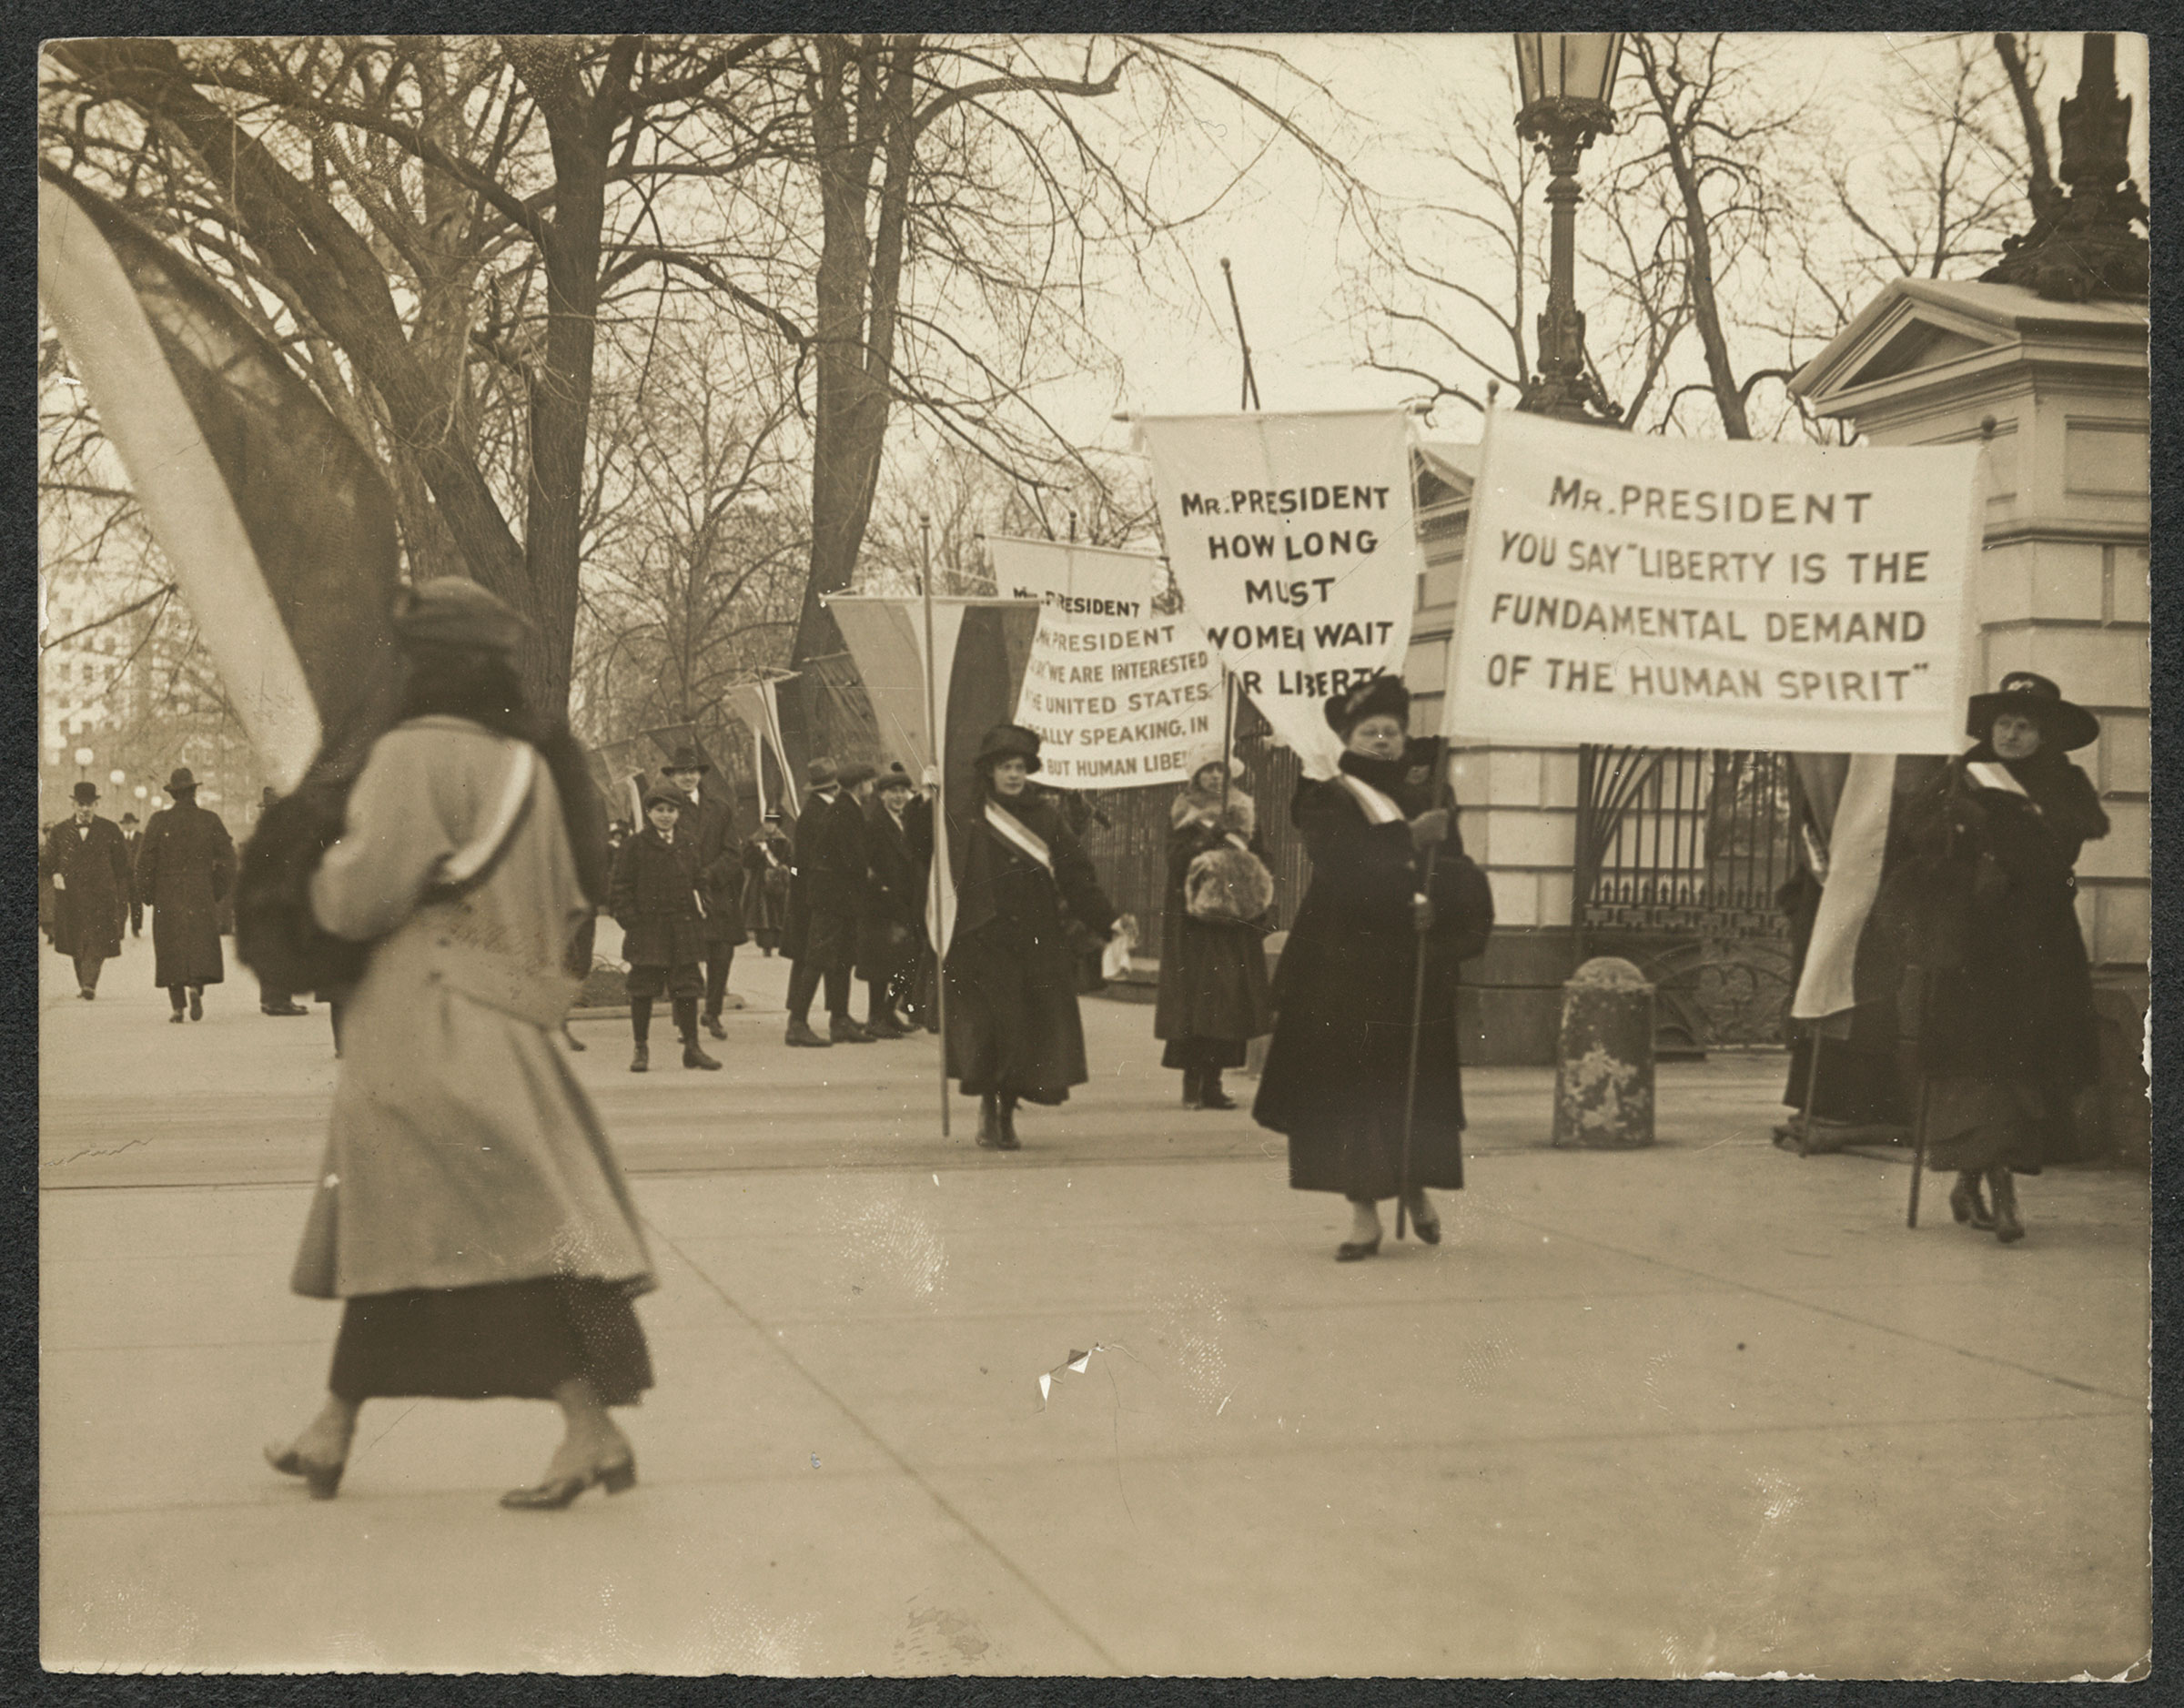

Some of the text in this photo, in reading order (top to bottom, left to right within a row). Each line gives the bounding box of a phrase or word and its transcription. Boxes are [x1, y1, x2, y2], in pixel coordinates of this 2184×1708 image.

[1180, 485, 1390, 517] MR. PRESIDENT
[1548, 475, 1873, 524] MR. PRESIDENT
[1208, 530, 1378, 561] HOW LONG
[1500, 529, 1556, 566] YOU
[1567, 539, 1621, 575] SAY
[1791, 551, 1825, 584] IS
[1847, 550, 1929, 583] THE
[1046, 591, 1141, 618] PRESIDENT
[1245, 577, 1335, 607] MUST
[1491, 592, 1926, 642] FUNDAMENTAL DEMAND
[1053, 625, 1176, 652] PRESIDENT
[1314, 622, 1394, 648] WAIT
[1069, 665, 1104, 683] ARE
[1111, 651, 1208, 682] INTERESTED
[1487, 653, 1929, 701] OF THE HUMAN SPIRIT"
[1046, 695, 1117, 715] UNITED
[1190, 715, 1208, 734] IN
[1046, 759, 1070, 777] BUT
[1077, 757, 1138, 777] HUMAN
